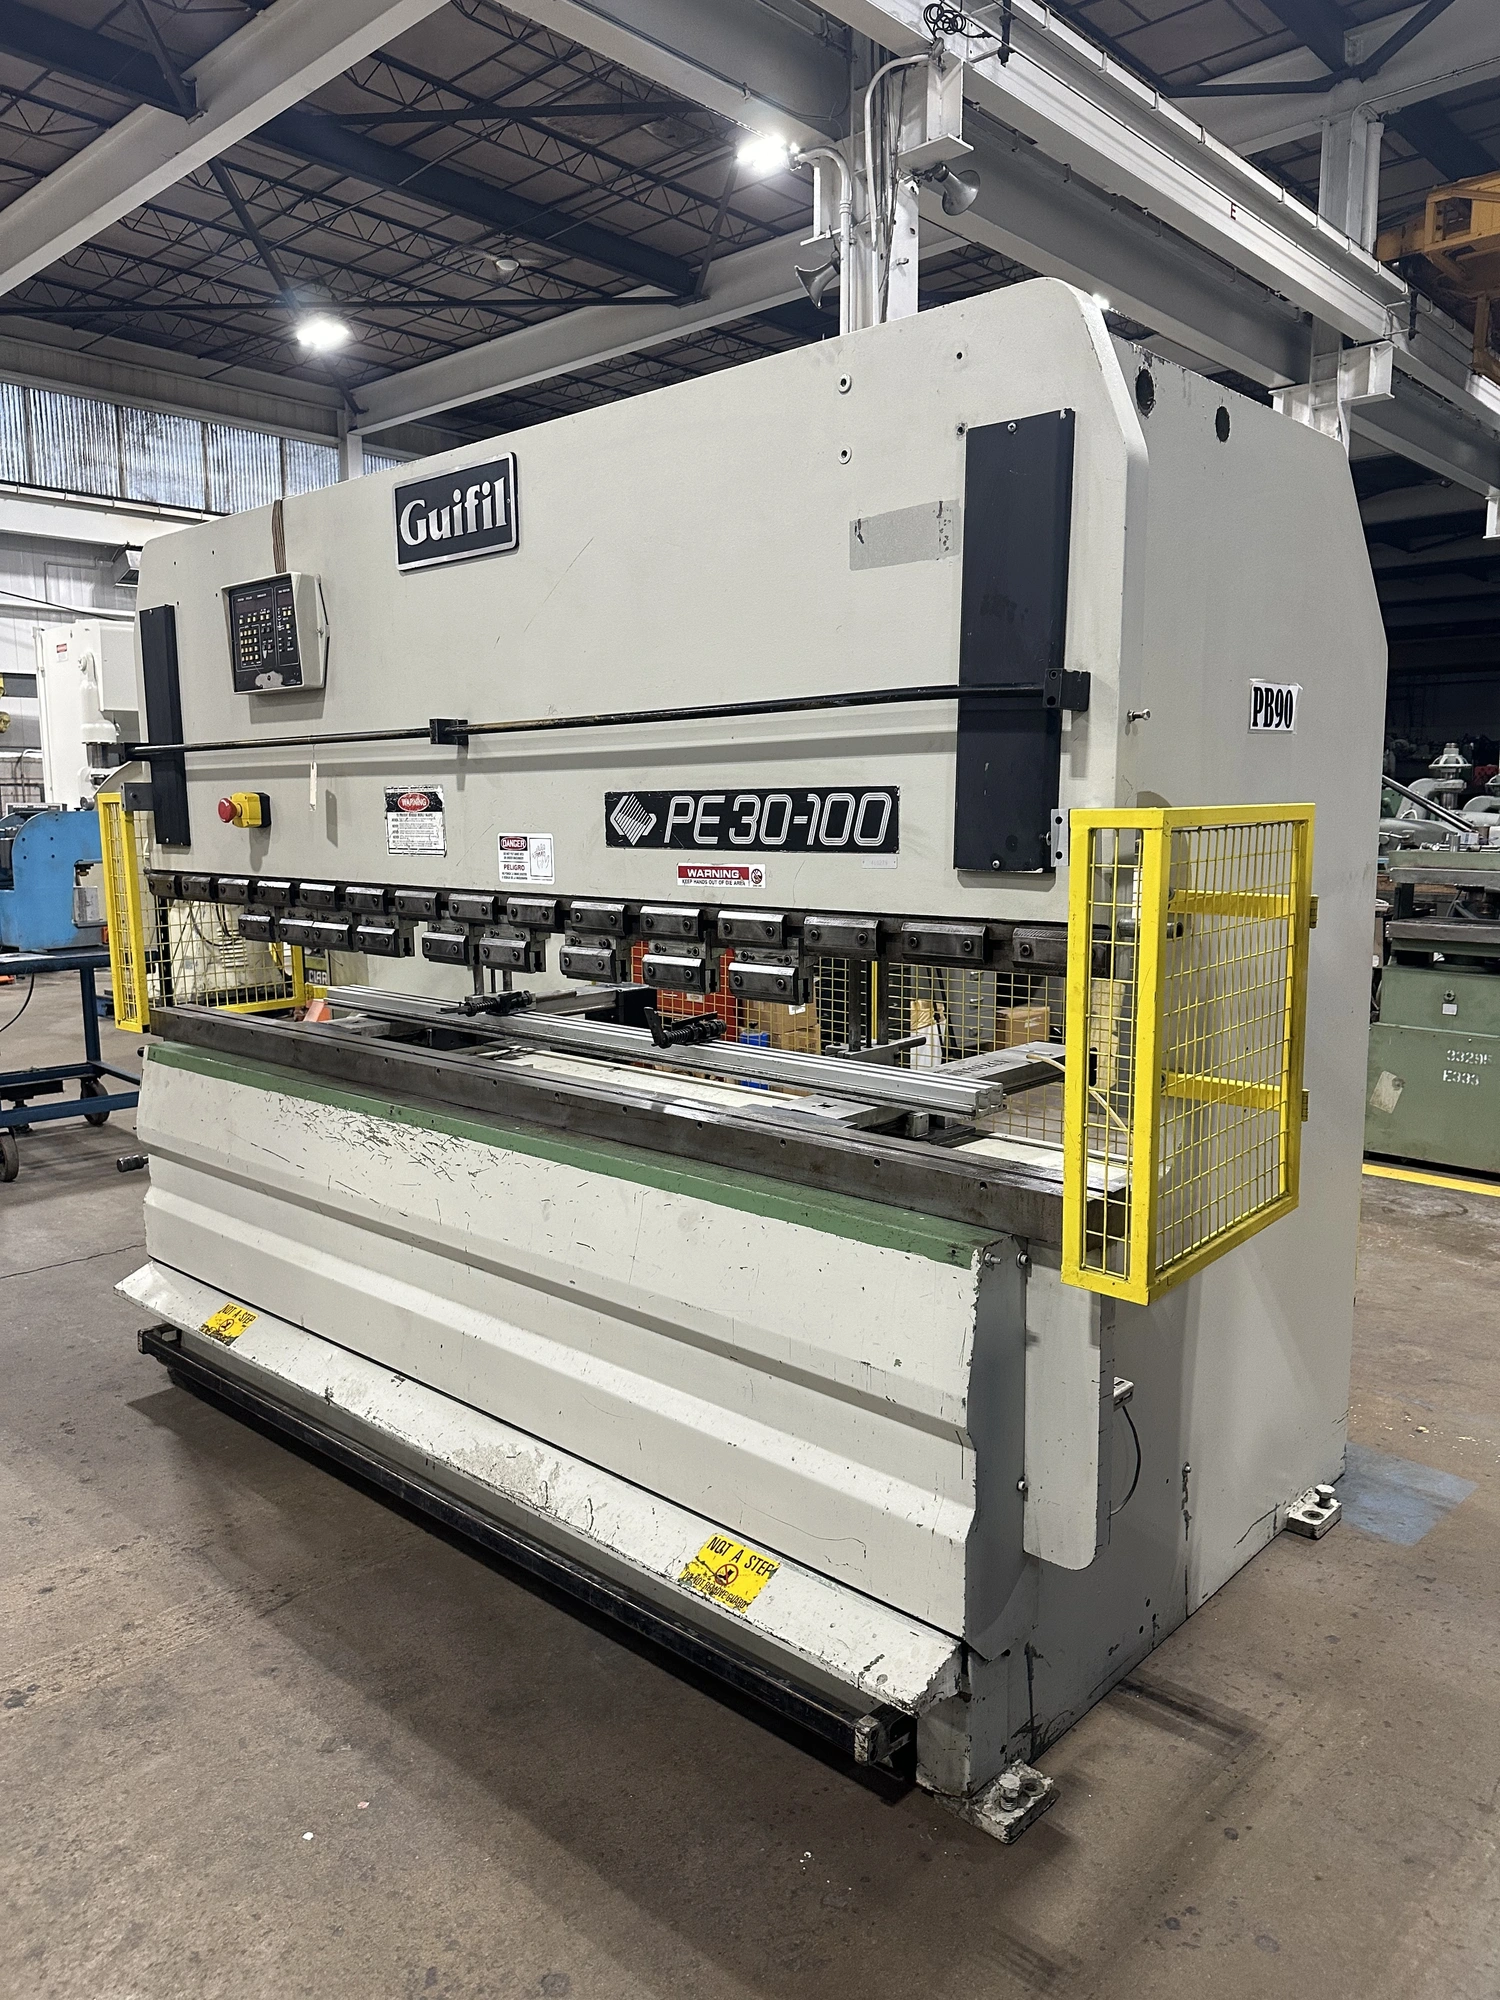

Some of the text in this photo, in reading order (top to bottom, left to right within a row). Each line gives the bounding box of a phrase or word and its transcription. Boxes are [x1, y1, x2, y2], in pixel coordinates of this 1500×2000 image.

[400, 477, 507, 546] Guifil
[1252, 686, 1294, 729] PB90
[502, 839, 525, 848] DANGER
[687, 868, 739, 879] WARNING
[706, 1536, 775, 1577] NOT A STEP
[725, 1593, 748, 1609] GUARD
